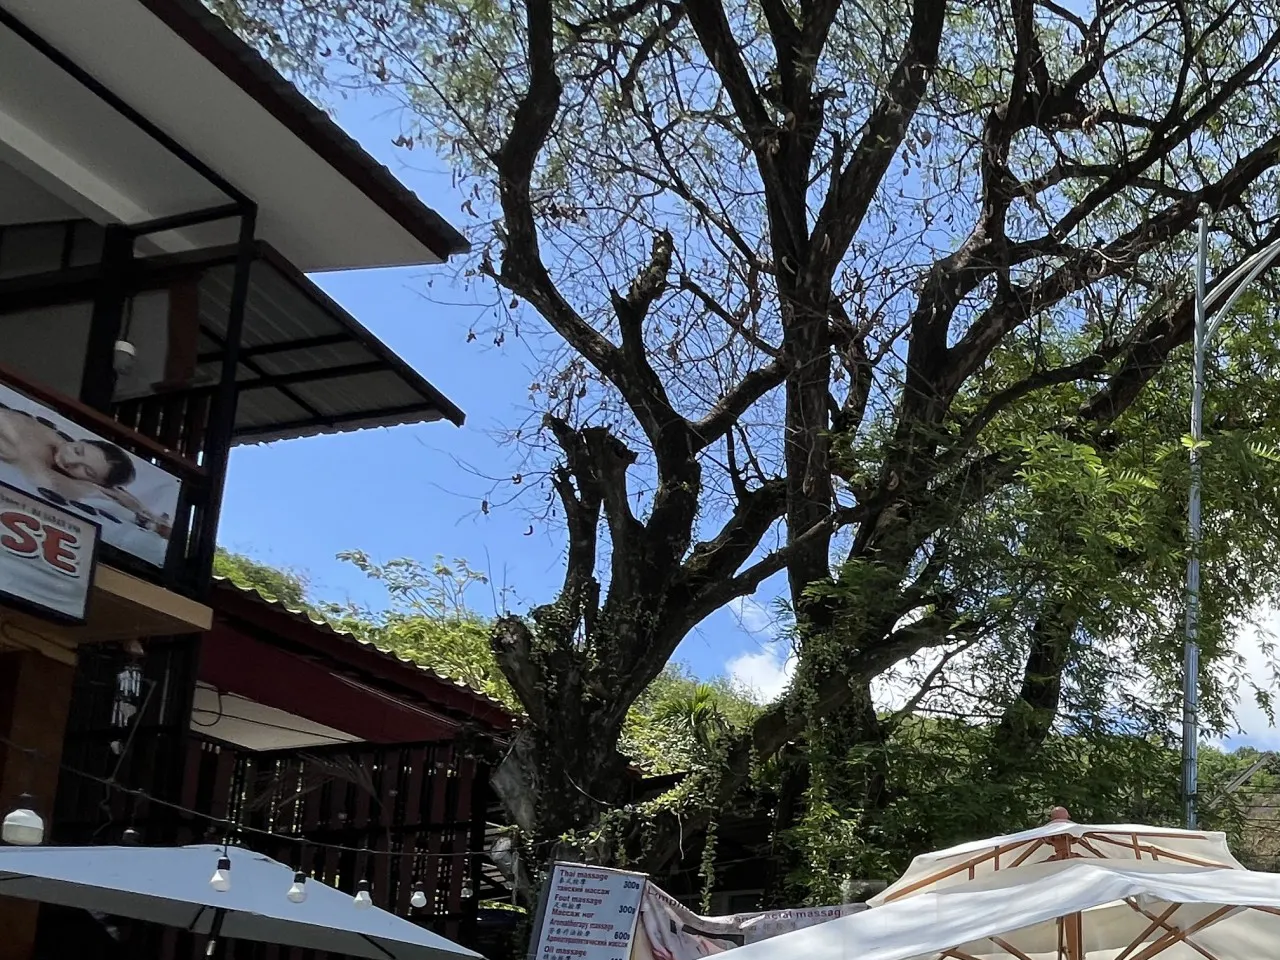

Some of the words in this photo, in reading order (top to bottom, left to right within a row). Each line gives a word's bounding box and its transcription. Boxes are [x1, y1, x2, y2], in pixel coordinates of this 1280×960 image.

[559, 869, 575, 877] Thai
[577, 872, 609, 881] massage
[555, 894, 570, 902] Foot
[572, 896, 602, 905] massage
[552, 908, 580, 917] Массаж
[796, 908, 844, 919] massag
[544, 945, 554, 953] Oil
[556, 948, 587, 957] massage
